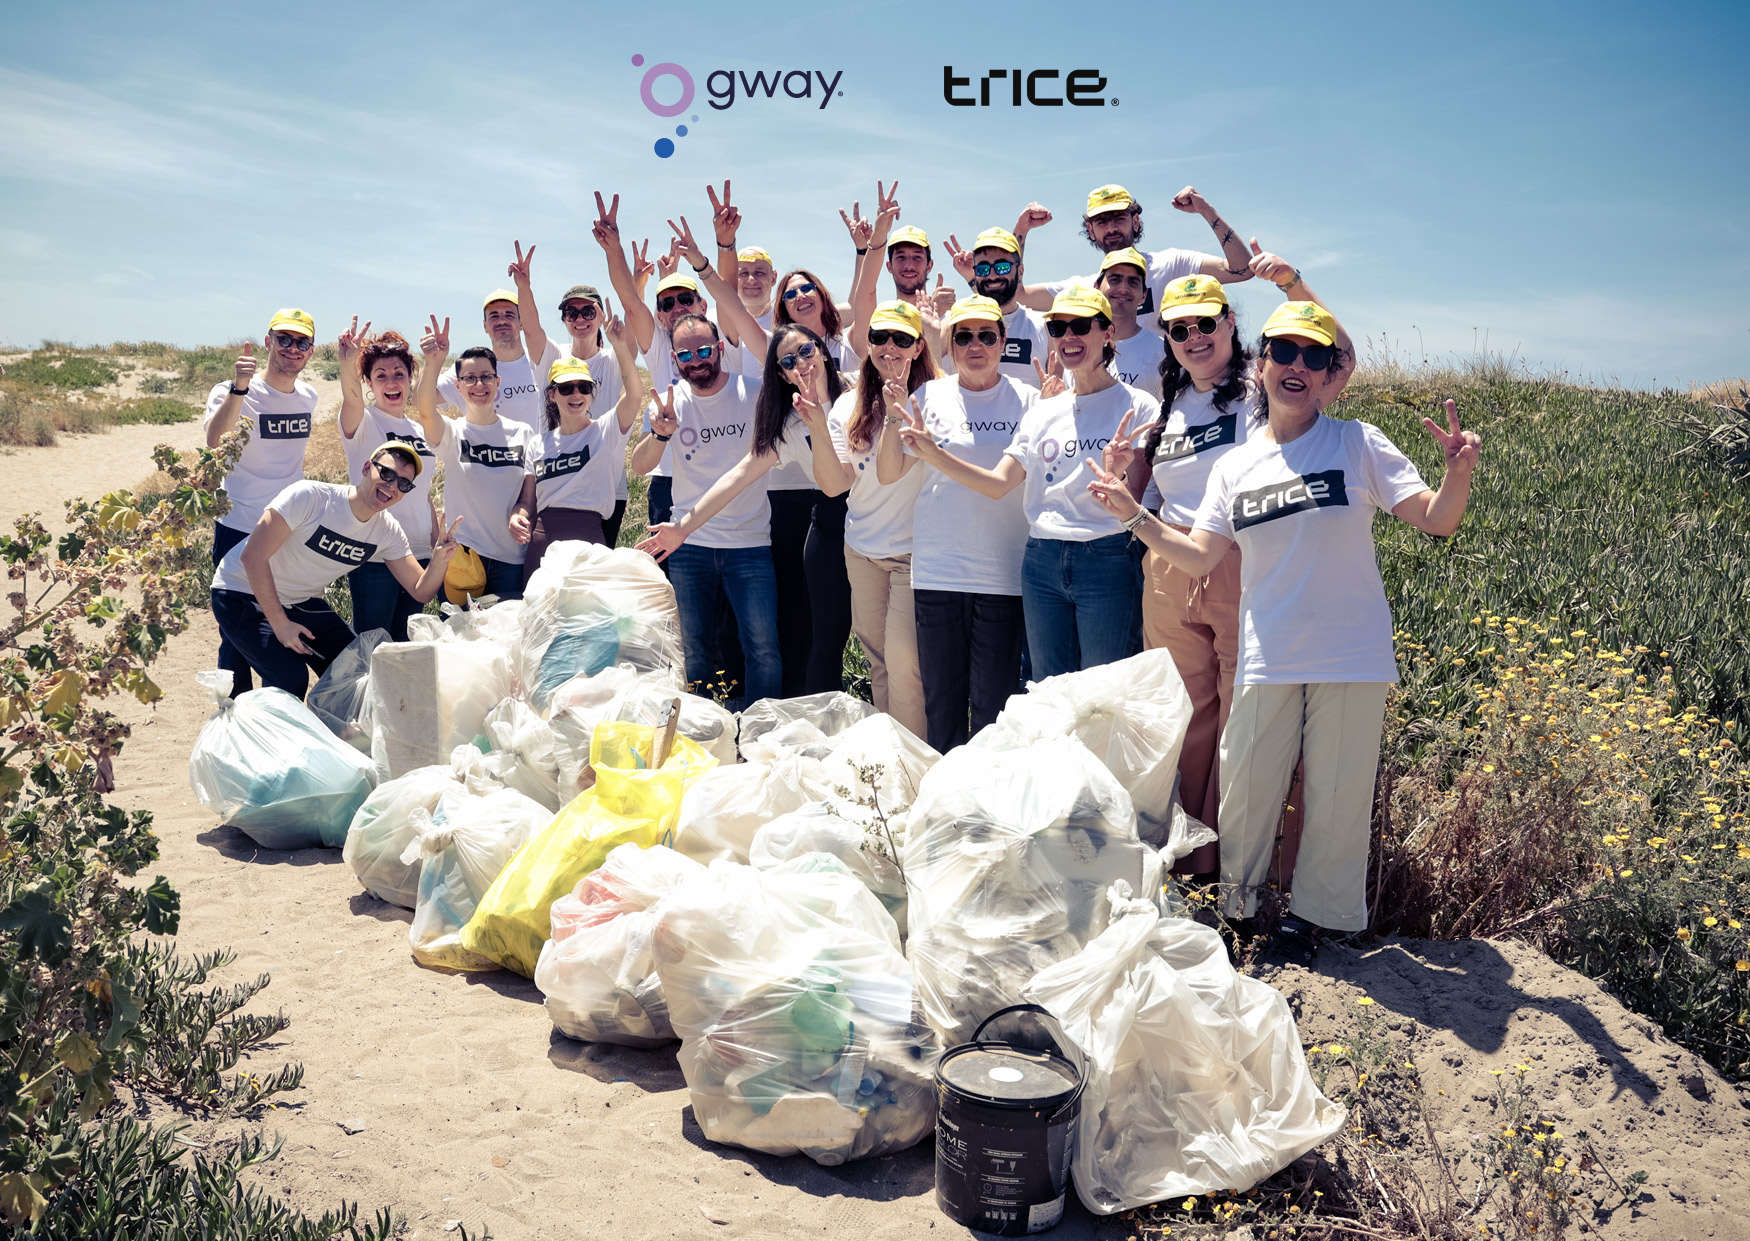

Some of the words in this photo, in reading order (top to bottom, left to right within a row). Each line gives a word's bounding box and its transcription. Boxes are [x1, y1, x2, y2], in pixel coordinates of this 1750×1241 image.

[503, 384, 540, 400] gwa
[267, 418, 309, 434] trice
[700, 422, 747, 444] gway
[960, 421, 1019, 435] gway
[1064, 437, 1111, 459] gwa
[1157, 425, 1223, 457] trice
[469, 445, 520, 463] trice
[535, 454, 582, 478] trice
[1242, 479, 1331, 519] trice
[318, 534, 367, 562] trice
